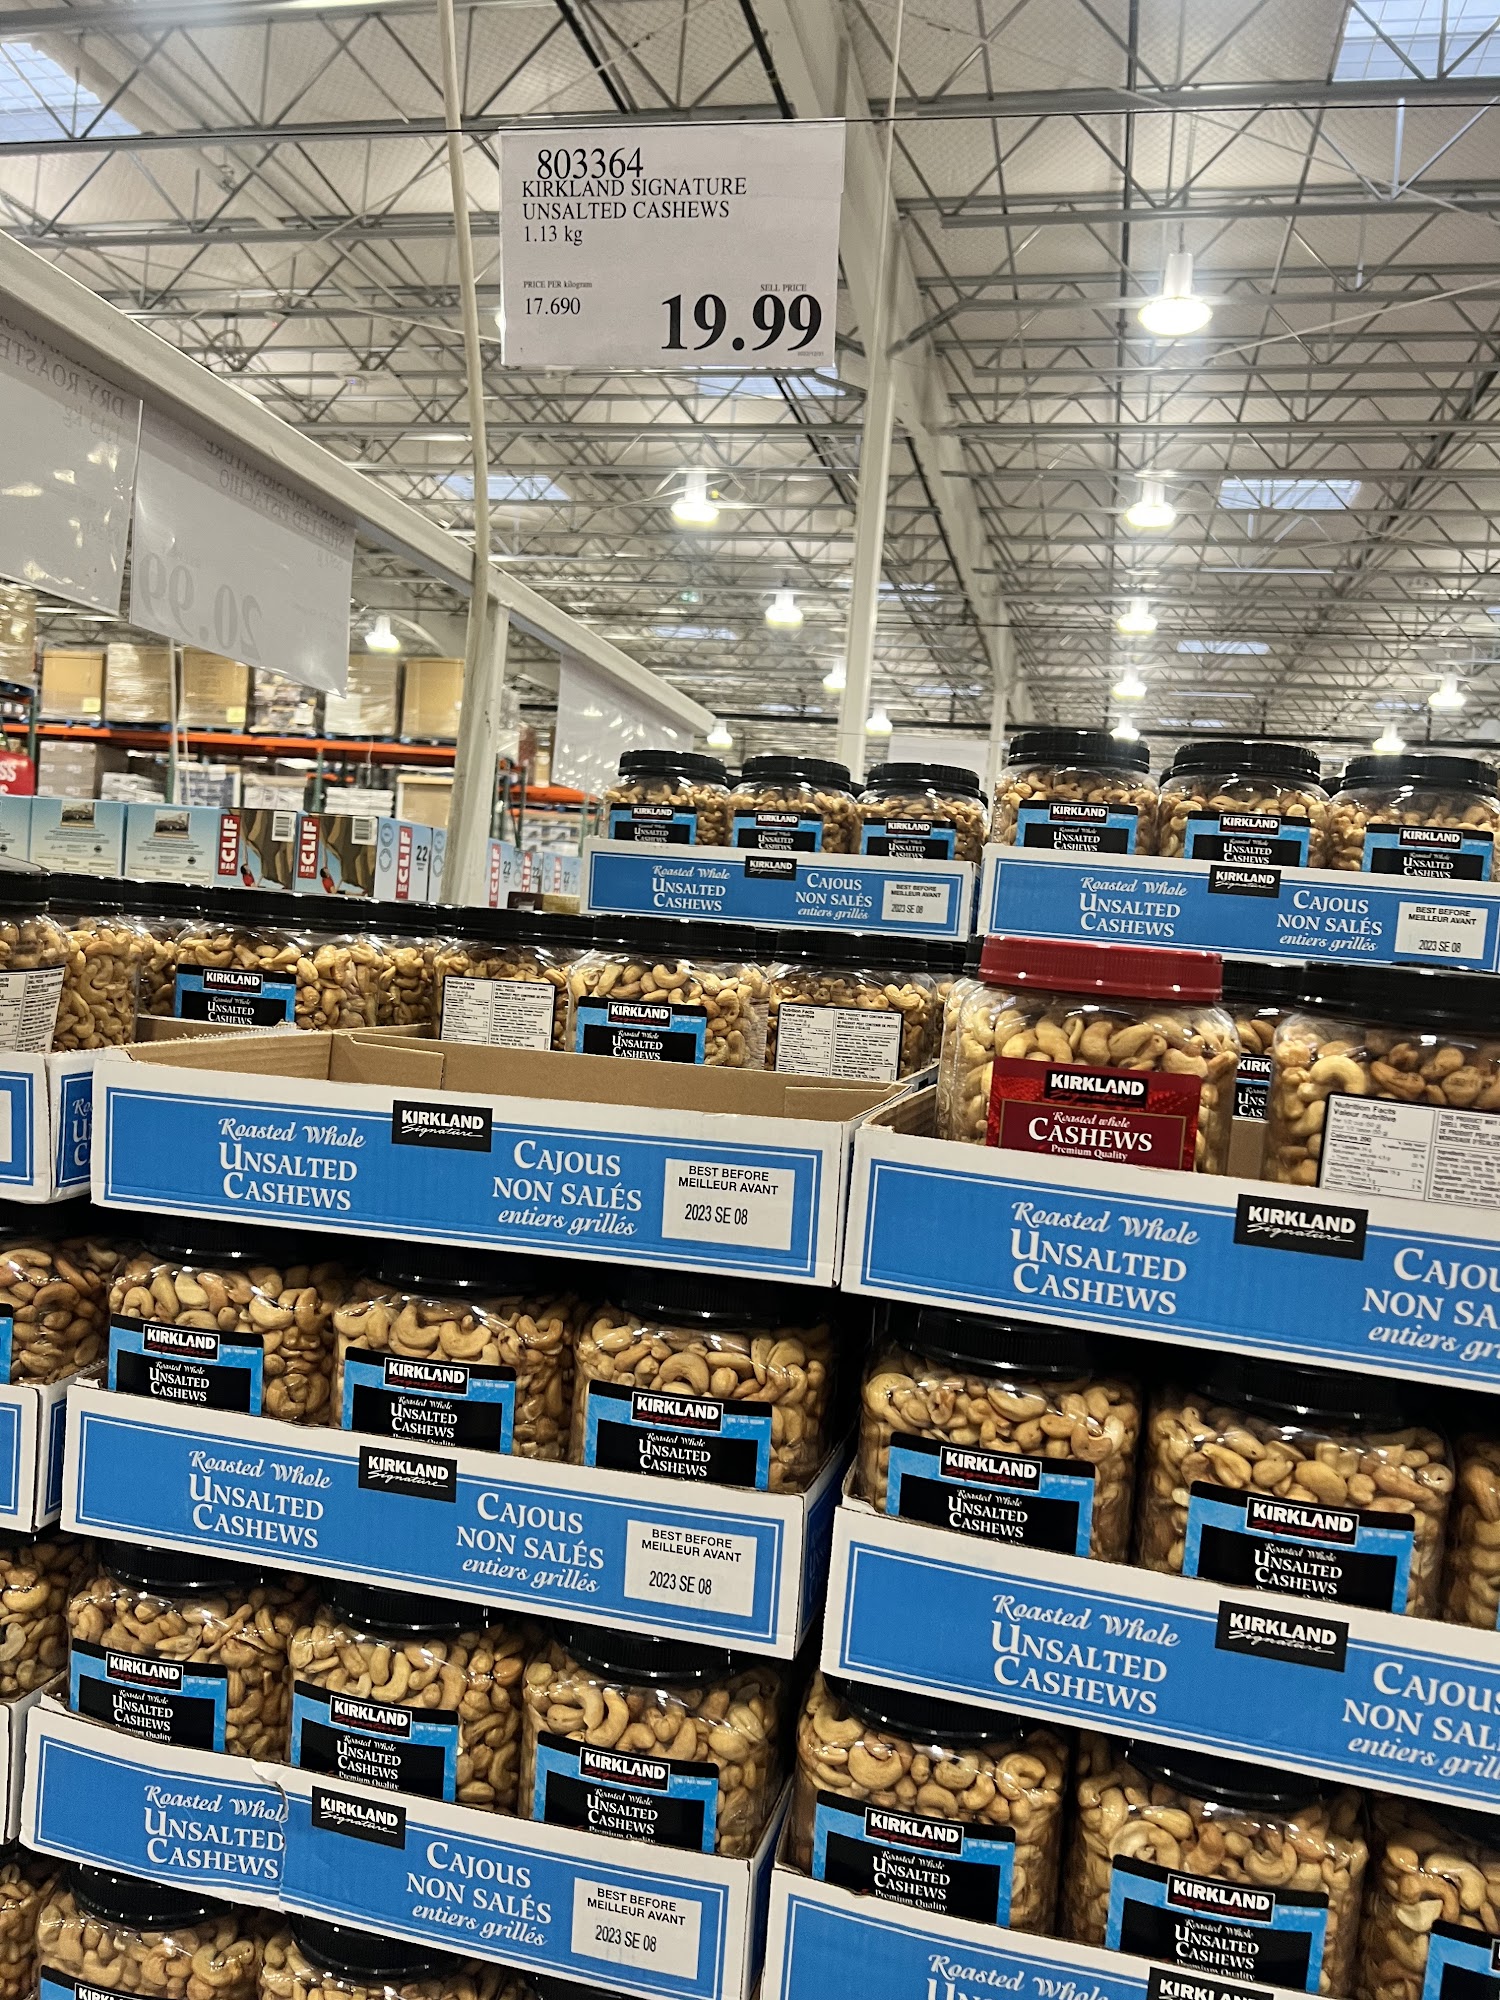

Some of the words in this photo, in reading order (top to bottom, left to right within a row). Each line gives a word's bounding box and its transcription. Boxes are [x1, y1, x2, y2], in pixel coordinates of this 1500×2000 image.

[536, 147, 643, 179] 803364
[522, 180, 624, 197] KIRKLAND
[631, 178, 747, 196] SIGNATURE
[523, 202, 626, 220] UNSALTED
[634, 201, 729, 218] CASHEWS
[524, 226, 557, 242] 1.13
[565, 225, 582, 245] kg
[563, 280, 592, 289] kilogram
[525, 298, 580, 315] 17.690
[662, 293, 821, 351] 19.99
[633, 808, 672, 816] KIRKLAND
[758, 814, 798, 824] KIRKLAND
[1052, 806, 1106, 817] KIRKLAND
[1222, 817, 1278, 829] KIRKLAND
[888, 822, 930, 832] KIRKLAND
[1403, 830, 1460, 843] KIRKLAND
[221, 819, 238, 862] CLIF
[302, 821, 317, 865] CLIF
[399, 831, 410, 883] CLIF
[416, 845, 427, 861] 22
[750, 860, 792, 870] KIRKLAND
[503, 861, 511, 874] 22
[652, 865, 694, 878] Roasted
[697, 868, 731, 880] Whole
[1216, 870, 1275, 884] KIRKLAND
[653, 878, 726, 896] UNSALTED
[807, 873, 862, 891] CAJOUS
[1080, 877, 1137, 892] Roasted
[1142, 881, 1188, 896] Whole
[654, 894, 722, 911] CASHEWS
[796, 892, 827, 905] NON
[831, 893, 873, 907] SALÉS
[906, 904, 914, 913] SE
[916, 905, 923, 914] 08
[1080, 894, 1180, 918] UNSALTED
[1293, 890, 1369, 914] CAJOUS
[798, 907, 832, 917] entiers
[835, 909, 869, 920] grillés
[1408, 914, 1449, 923] MEILLEUR
[1450, 917, 1476, 925] AVANT
[1439, 908, 1470, 916] BEFORE
[1080, 912, 1174, 937] CASHEWS
[1277, 914, 1321, 930] NON
[1325, 917, 1382, 935] SALÉS
[1280, 933, 1327, 948] entiers
[1328, 936, 1378, 951] grillés
[1418, 940, 1437, 951] 2023
[1439, 941, 1450, 952] SE
[1452, 942, 1461, 953] 08
[205, 972, 260, 986] KIRKLAND
[611, 1005, 669, 1019] KIRKLAND
[612, 1035, 663, 1050] UNSALTED
[613, 1046, 660, 1060] CASHEWS
[1051, 1073, 1145, 1096] KIRKLAND
[1053, 1111, 1096, 1126] Roasted
[1334, 1101, 1370, 1111] Nutrition
[1373, 1106, 1396, 1114] Facts
[402, 1110, 484, 1130] KIRKLAND
[218, 1118, 297, 1142] Roasted
[302, 1125, 366, 1148] Whole
[1029, 1117, 1152, 1152] CASHEWS
[219, 1142, 357, 1182] UNSALTED
[514, 1140, 621, 1177] CAJOUS
[1051, 1144, 1091, 1156] Premium
[1094, 1149, 1128, 1162] Quality
[689, 1165, 719, 1177] BEST
[722, 1168, 769, 1182] BEFORE
[223, 1172, 351, 1211] CASHEWS
[493, 1177, 553, 1202] NON
[561, 1182, 642, 1212] SALÉS
[679, 1177, 738, 1192] MEILLEUR
[740, 1183, 779, 1195] AVANT
[498, 1206, 567, 1229] entiers
[568, 1211, 638, 1237] grillés
[685, 1203, 712, 1222] 2023
[715, 1206, 731, 1224] SE
[734, 1207, 748, 1225] 08
[1011, 1201, 1111, 1233] Roasted
[1119, 1214, 1201, 1246] Whole
[1249, 1205, 1356, 1234] KIRKLAND
[1011, 1228, 1187, 1283] UNSALTED
[1013, 1264, 1177, 1315] CASHEWS
[147, 1329, 215, 1349] KIRKLAND
[389, 1362, 465, 1384] KIRKLAND
[636, 1396, 719, 1419] KIRKLAND
[189, 1451, 267, 1479] Roasted
[272, 1462, 333, 1489] Whole
[368, 1456, 448, 1480] KIRKLAND
[946, 1452, 1037, 1478] KIRKLAND
[189, 1473, 324, 1520] UNSALTED
[477, 1493, 583, 1534] CAJOUS
[948, 1496, 1028, 1523] UNSALTED
[1253, 1503, 1353, 1532] KIRKLAND
[192, 1504, 319, 1549] CASHEWS
[949, 1512, 1024, 1538] CASHEWS
[457, 1526, 517, 1554] NON
[523, 1537, 604, 1570] SALÉS
[641, 1539, 700, 1557] MEILLEUR
[702, 1548, 741, 1563] AVANT
[652, 1529, 683, 1542] BEST
[686, 1533, 732, 1549] BEFORE
[462, 1557, 530, 1582] entiers
[530, 1568, 600, 1593] grillés
[649, 1570, 676, 1590] 2023
[678, 1574, 695, 1592] SE
[698, 1578, 712, 1594] 08
[992, 1594, 1092, 1630] Roasted
[1100, 1614, 1181, 1648] Whole
[1230, 1612, 1336, 1645] KIRKLAND
[991, 1621, 1167, 1683] UNSALTED
[110, 1656, 179, 1680] KIRKLAND
[994, 1656, 1158, 1715] CASHEWS
[335, 1702, 407, 1726] KIRKLAND
[585, 1752, 665, 1779] KIRKLAND
[144, 1785, 223, 1812] Roasted
[321, 1797, 397, 1826] KIRKLAND
[144, 1807, 284, 1851] UNSALTED
[870, 1813, 959, 1843] KIRKLAND
[147, 1839, 278, 1879] CASHEWS
[427, 1842, 531, 1888] CAJOUS
[406, 1872, 470, 1903] NON
[473, 1888, 552, 1923] SALÉS
[597, 1888, 626, 1901] BEST
[629, 1895, 676, 1911] BEFORE
[1173, 1880, 1270, 1911] KIRKLAND
[587, 1898, 645, 1918] MEILLEUR
[648, 1910, 686, 1926] AVANT
[412, 1904, 479, 1930] entiers
[479, 1919, 548, 1946] grillés
[596, 1925, 621, 1945] 2023
[624, 1932, 641, 1949] SE
[643, 1935, 657, 1952] 08
